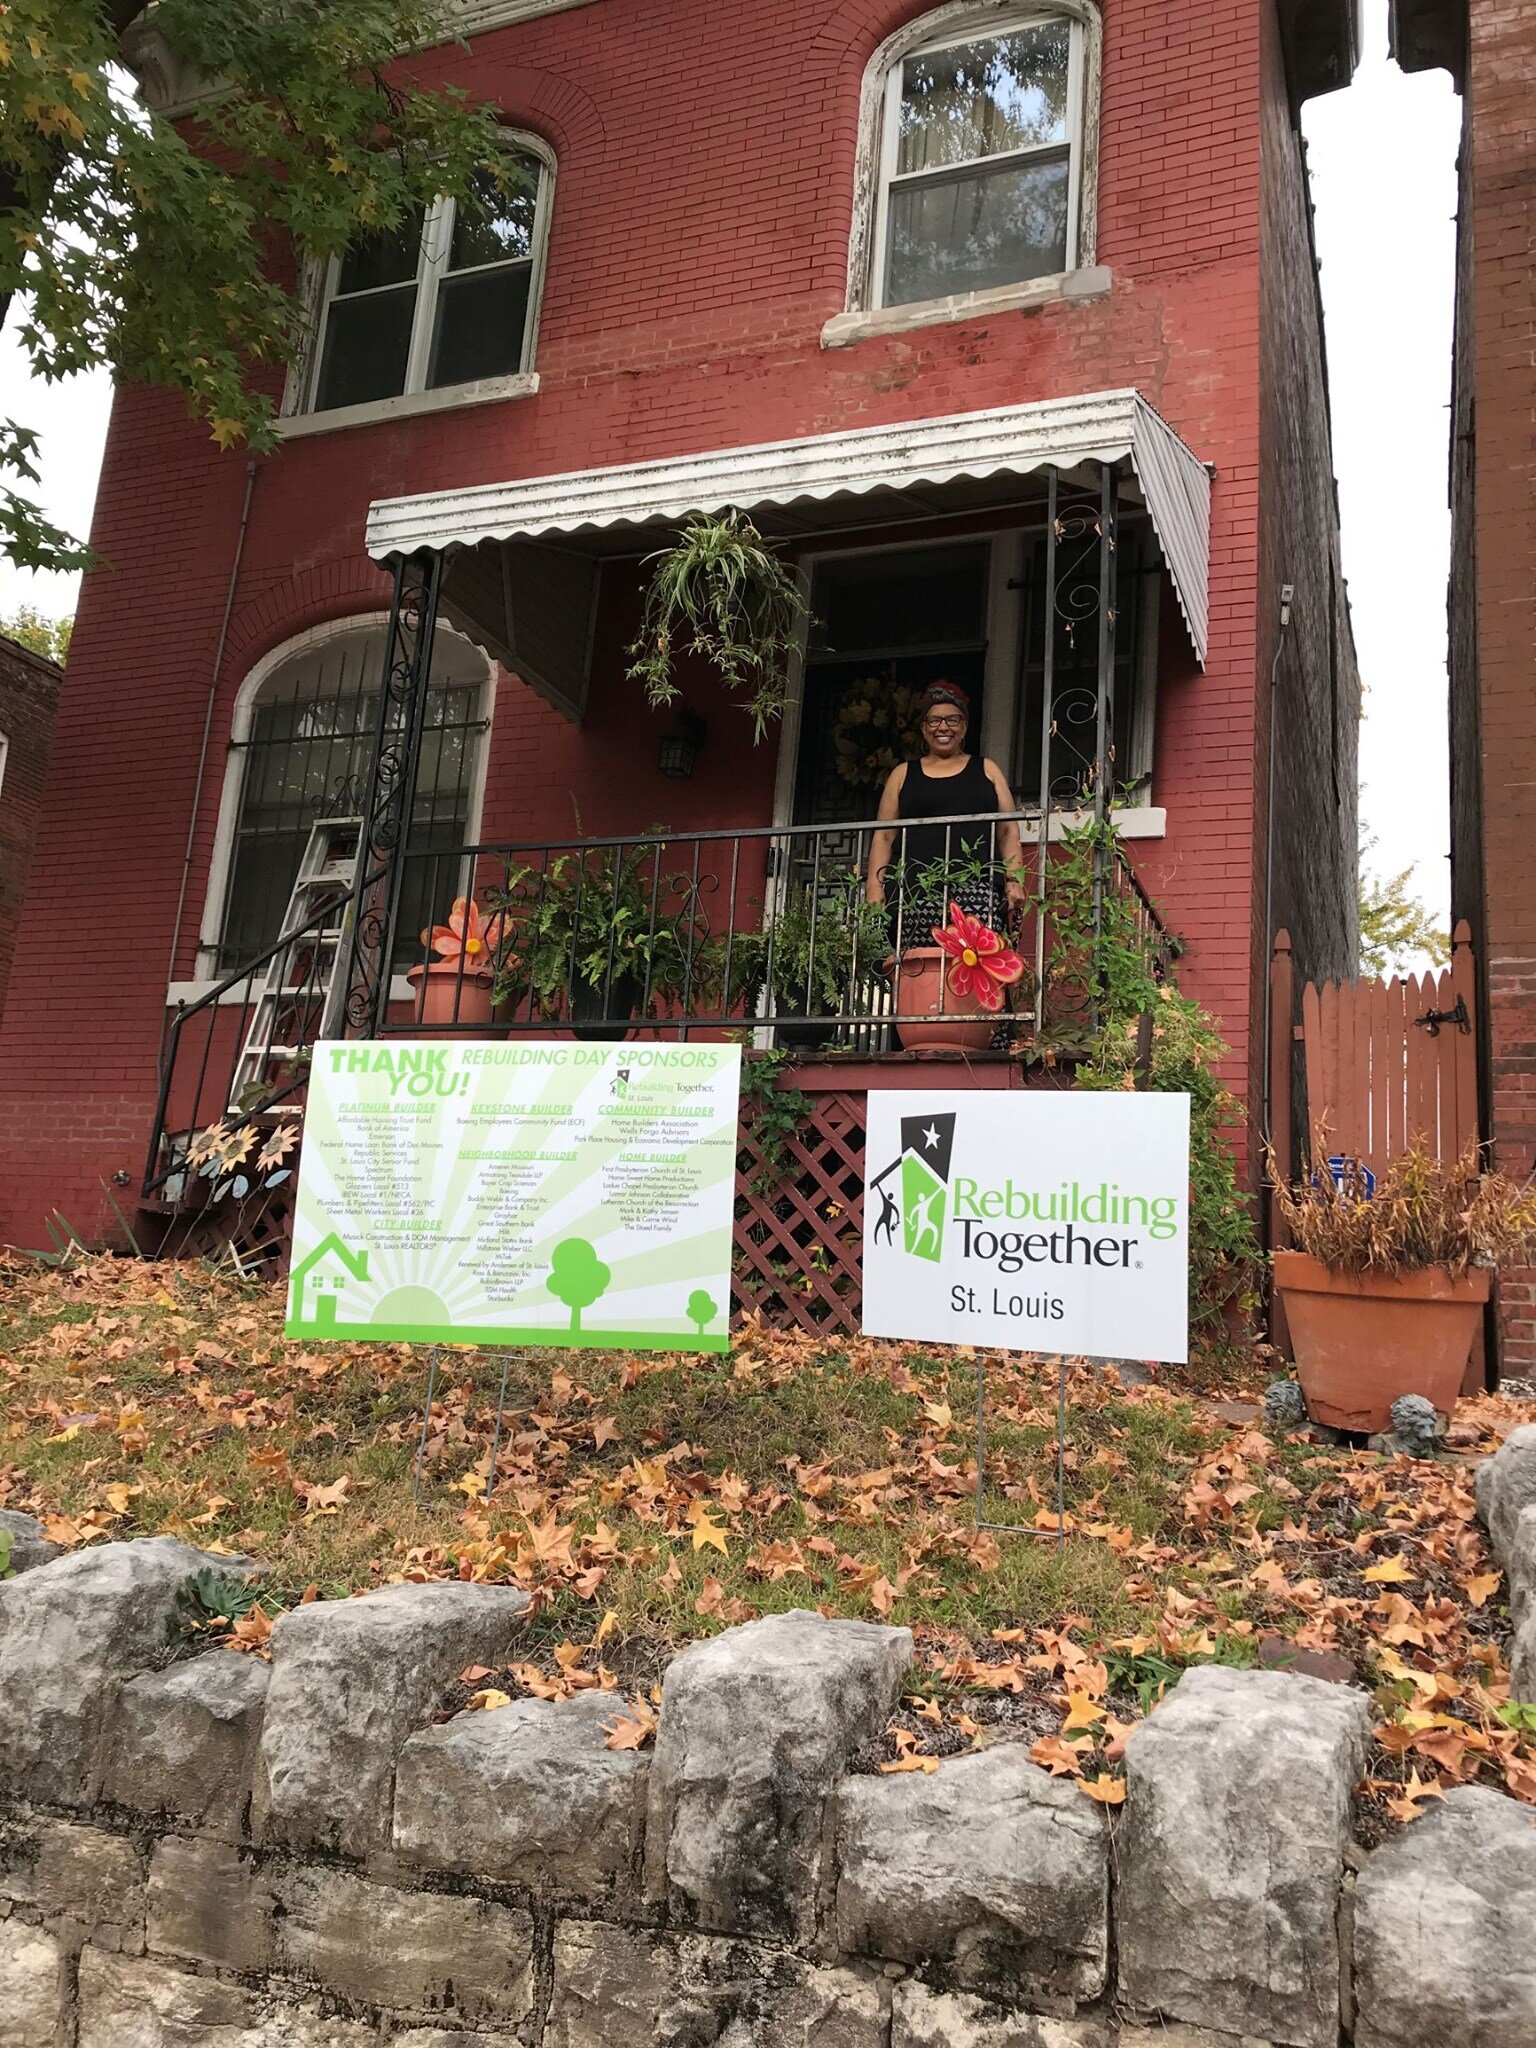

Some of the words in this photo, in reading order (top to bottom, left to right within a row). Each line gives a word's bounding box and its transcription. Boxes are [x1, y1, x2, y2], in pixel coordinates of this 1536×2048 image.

[330, 1049, 449, 1073] THANK
[461, 1049, 568, 1065] REBUILDING
[573, 1050, 610, 1065] DAY
[616, 1050, 718, 1067] SPONSORS
[388, 1072, 470, 1096] YOU!
[339, 1103, 390, 1112] PLATINUM
[394, 1103, 436, 1113] BUILDER
[471, 1104, 526, 1114] KEYSTONE
[530, 1105, 573, 1115] BUILDER
[598, 1105, 667, 1115] COMMUNITY
[671, 1107, 714, 1116] BUILDER
[372, 1117, 397, 1125] Housing
[457, 1118, 478, 1126] Boeing
[514, 1119, 549, 1127] Community
[640, 1128, 659, 1136] Fargo
[605, 1136, 627, 1144] Housing
[663, 1138, 699, 1146] Development
[701, 1138, 733, 1146] Corporation
[459, 1150, 536, 1159] NEIGHBORHOOD
[540, 1152, 577, 1161] BUILDER
[619, 1153, 647, 1161] HOME
[650, 1154, 687, 1163] BUILDER
[368, 1158, 380, 1166] City
[643, 1183, 677, 1191] Presbyterian
[953, 1177, 1177, 1240] Rebuilding
[373, 1220, 396, 1229] CITY
[401, 1220, 442, 1230] BUILDER
[654, 1224, 672, 1232] Family
[430, 1235, 470, 1243] Management
[951, 1285, 982, 1313] St.
[993, 1288, 1064, 1320] Louis
